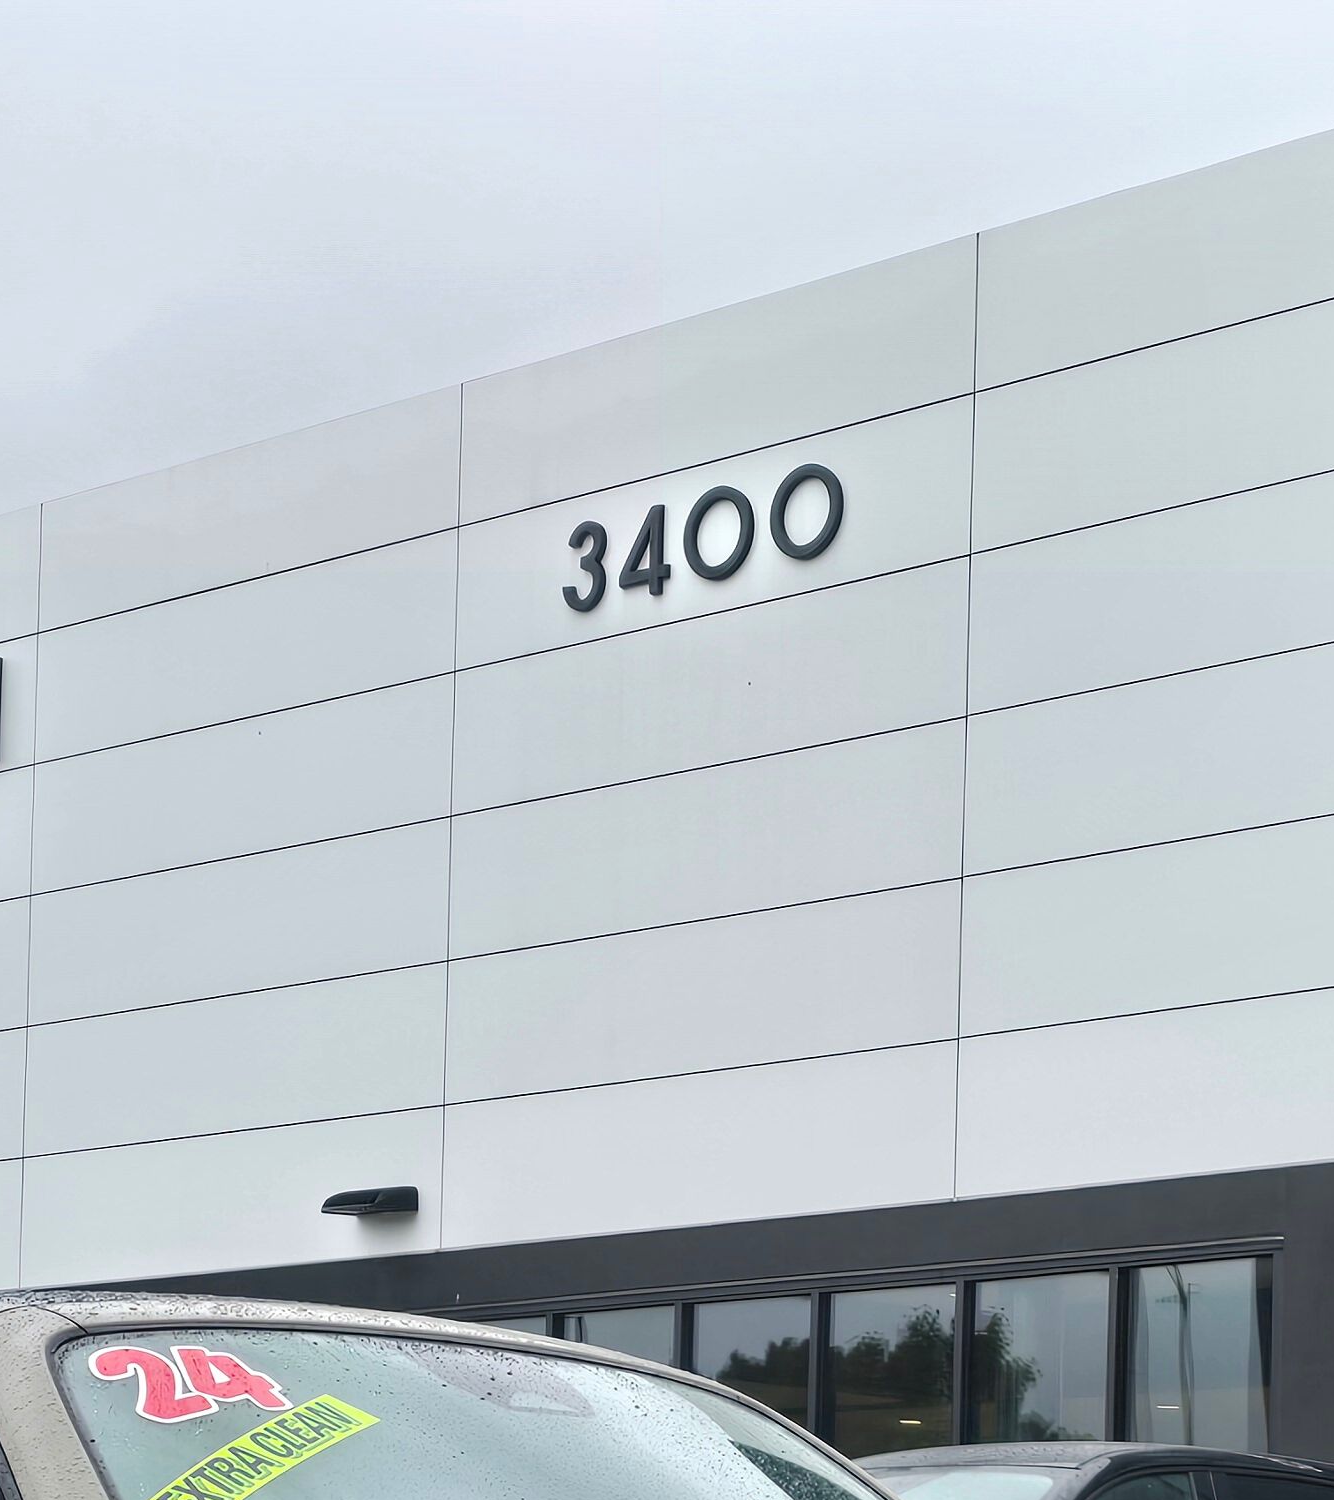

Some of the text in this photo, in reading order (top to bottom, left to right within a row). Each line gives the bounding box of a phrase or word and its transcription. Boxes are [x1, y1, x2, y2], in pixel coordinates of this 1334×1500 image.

[562, 463, 844, 612] 3400
[88, 1346, 294, 1423] 24
[249, 1401, 362, 1460] CLEAN
